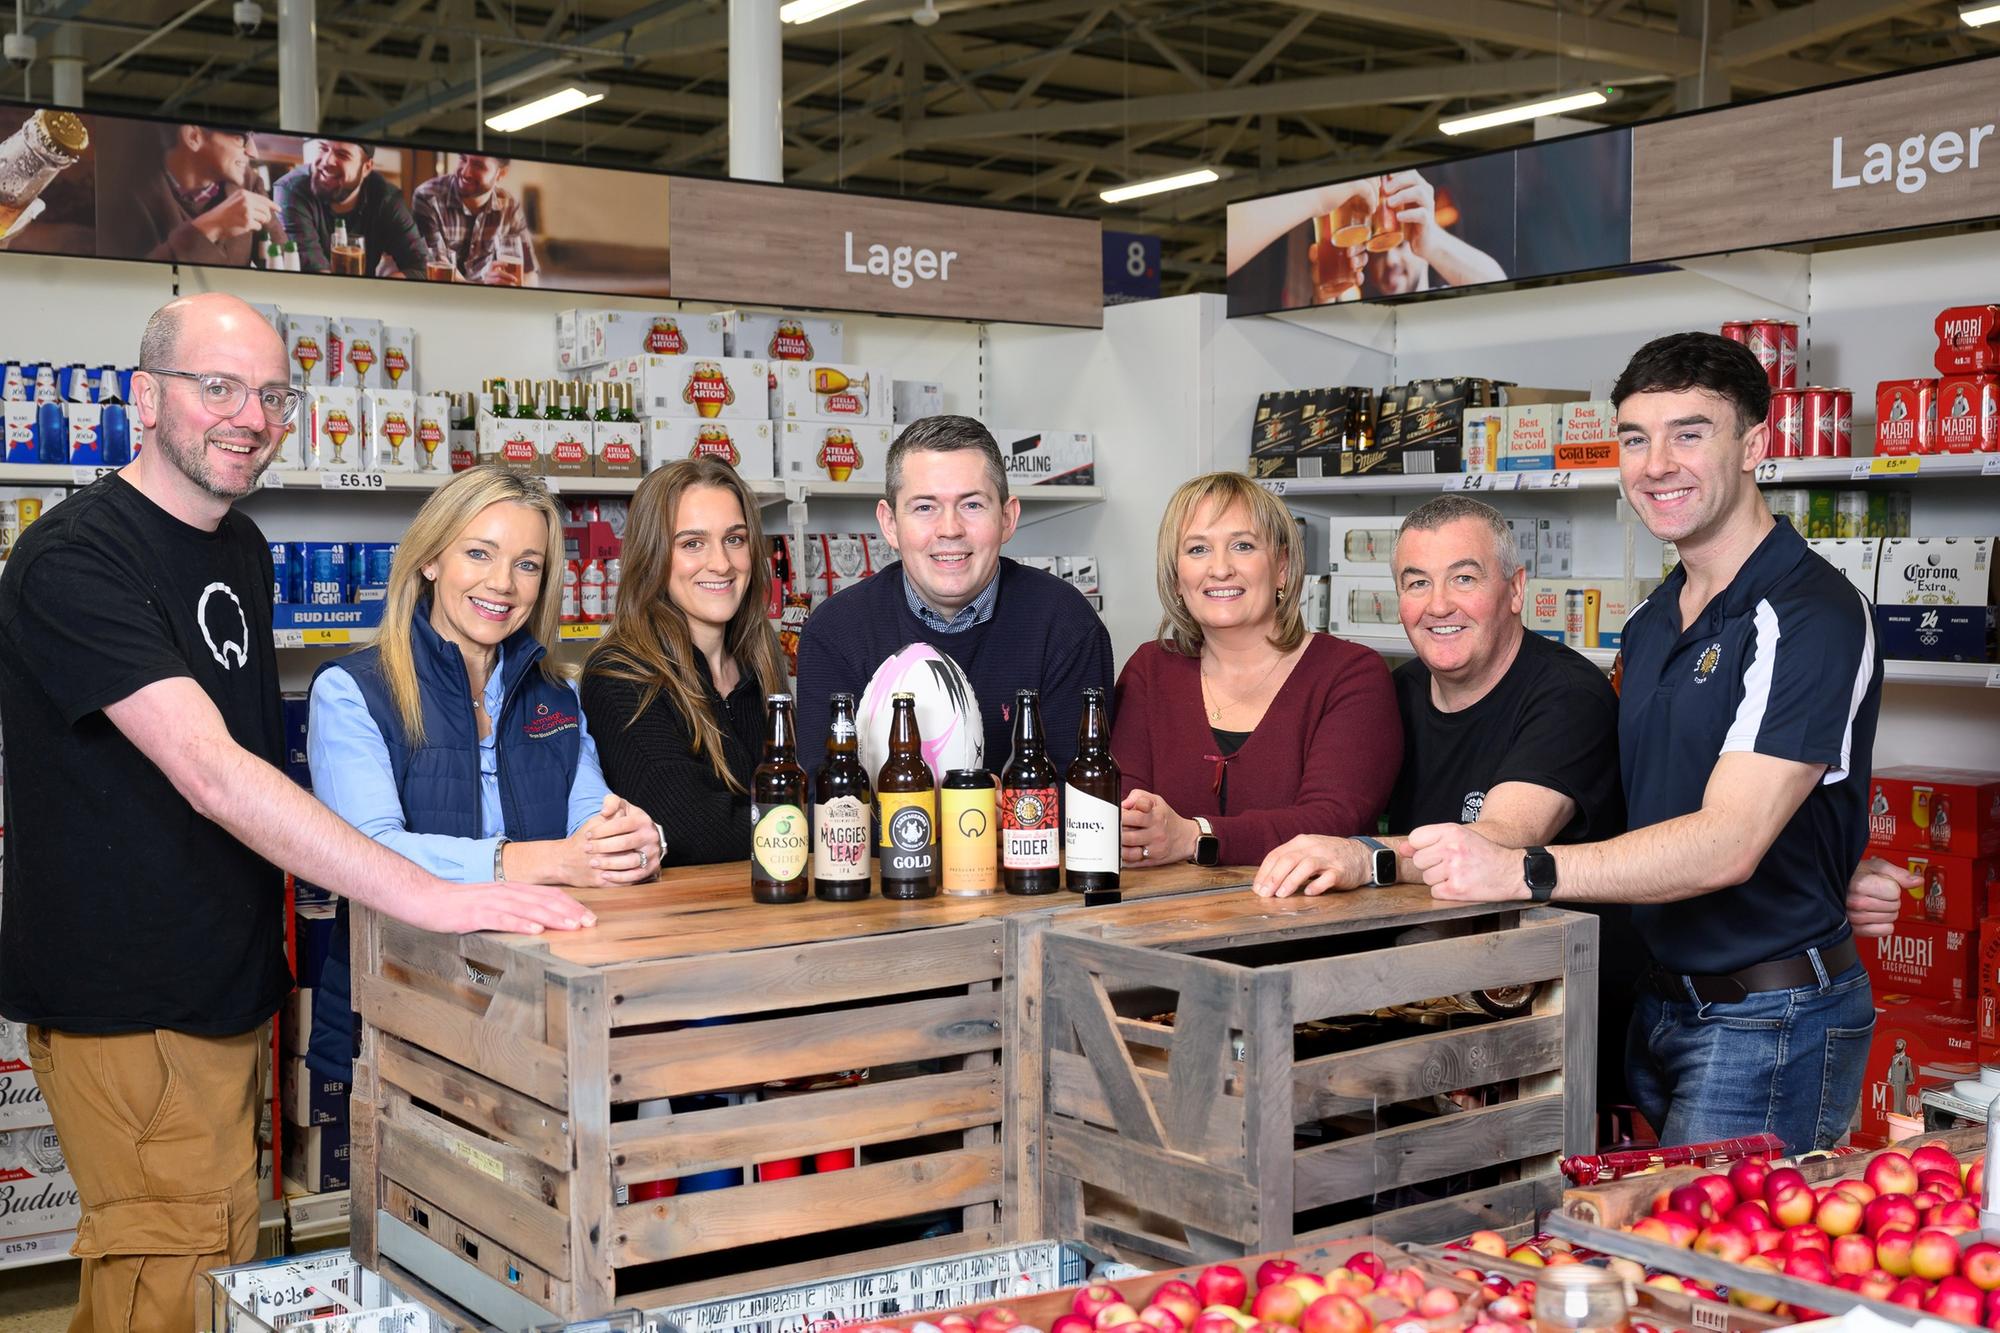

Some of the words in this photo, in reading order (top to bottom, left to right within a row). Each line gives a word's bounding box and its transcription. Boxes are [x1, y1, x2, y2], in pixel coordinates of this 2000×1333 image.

[1832, 124, 1995, 194] Lager
[845, 231, 958, 289] Lager
[1126, 241, 1146, 277] 8
[1945, 316, 1981, 338] MADRÍ
[652, 333, 679, 342] STELLA
[777, 337, 805, 346] STELLA
[652, 340, 680, 349] ARTOIS
[777, 346, 805, 354] ARTOIS
[693, 381, 725, 391] STELLA
[692, 390, 725, 399] ARTOIS
[1575, 407, 1596, 418] Best
[1519, 418, 1540, 428] Best
[1569, 419, 1601, 429] Served
[1880, 419, 1914, 439] MADRÍ
[1942, 415, 1976, 436] MADRÍ
[385, 428, 407, 436] ARTOIS
[1513, 428, 1544, 439] Served
[1566, 432, 1580, 441] Ice
[1582, 429, 1603, 440] Cold
[699, 443, 730, 452] STELLA
[826, 447, 855, 456] STELLA
[1511, 441, 1523, 451] Ice
[1525, 440, 1546, 450] Cold
[826, 454, 855, 463] ARTOIS
[1559, 447, 1585, 460] Cold
[1586, 446, 1611, 459] Beer
[1003, 455, 1051, 472] CARLING
[1355, 451, 1388, 473] Miller
[340, 474, 382, 487] £6.19
[1463, 475, 1482, 489] £4
[1551, 473, 1571, 487] £4
[1904, 564, 1959, 584] Corona
[314, 582, 339, 592] BUD
[1917, 580, 1946, 592] Extra
[1536, 594, 1557, 605] Cold
[294, 612, 322, 623] BUD
[324, 612, 362, 622] LIGHT
[1536, 606, 1557, 617] Beer
[1868, 815, 1896, 835] ADRÍ
[1012, 839, 1048, 855] CIDER
[770, 855, 800, 864] CIDER
[830, 845, 860, 865] LEAP
[893, 855, 931, 869] GOLD
[1878, 935, 1933, 967] MADRÍ
[1882, 961, 1927, 977] EXCEPCIONAL
[1985, 998, 1993, 1010] 12
[324, 1083, 344, 1093] BIER
[334, 1147, 351, 1158] BIE
[6, 1242, 38, 1254] £15.79
